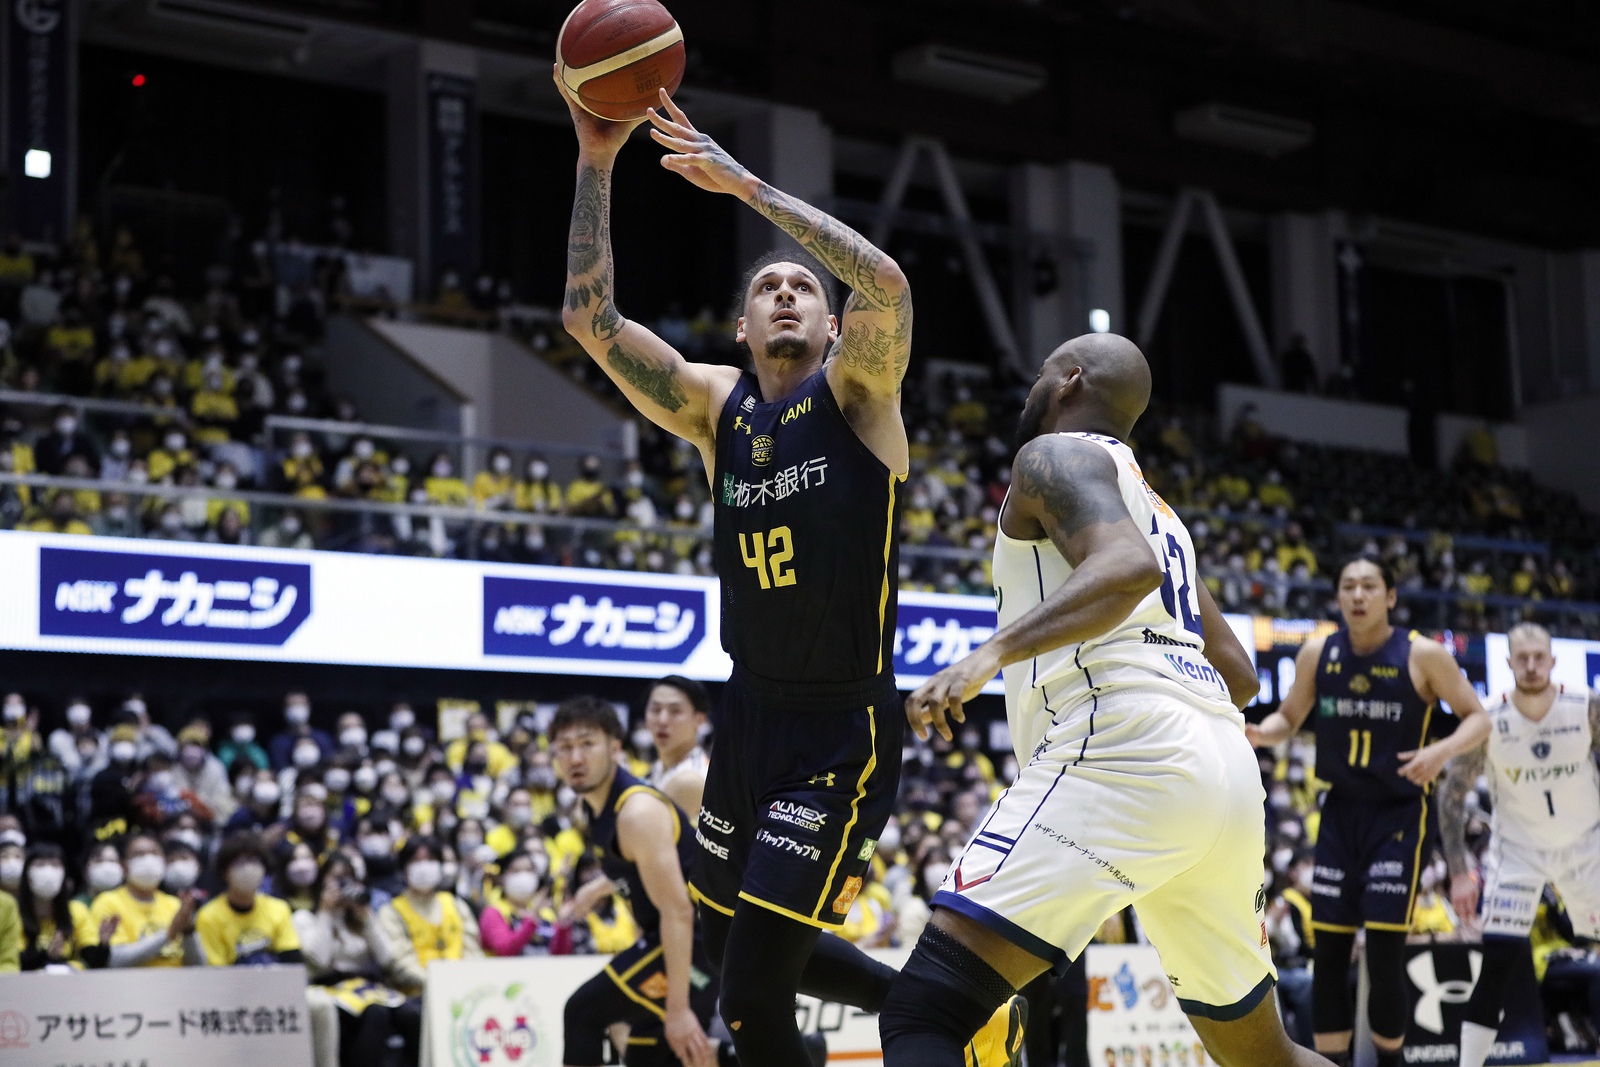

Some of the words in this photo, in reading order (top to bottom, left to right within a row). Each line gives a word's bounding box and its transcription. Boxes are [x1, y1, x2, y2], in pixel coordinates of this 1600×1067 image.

[733, 456, 829, 508] 栃木銀行
[738, 525, 797, 590] 42
[120, 569, 298, 630] ナカニシ
[549, 594, 695, 650] ナカニシ
[1349, 728, 1372, 768] 11
[767, 810, 821, 833] TECHNOLOGIES
[769, 800, 828, 825] ALMEX
[1544, 789, 1556, 817] 1
[1034, 823, 1136, 892] サザンインターナショナル株式会社
[37, 1007, 301, 1042] アサヒフード株式会社
[1403, 1043, 1459, 1063] UNDER
